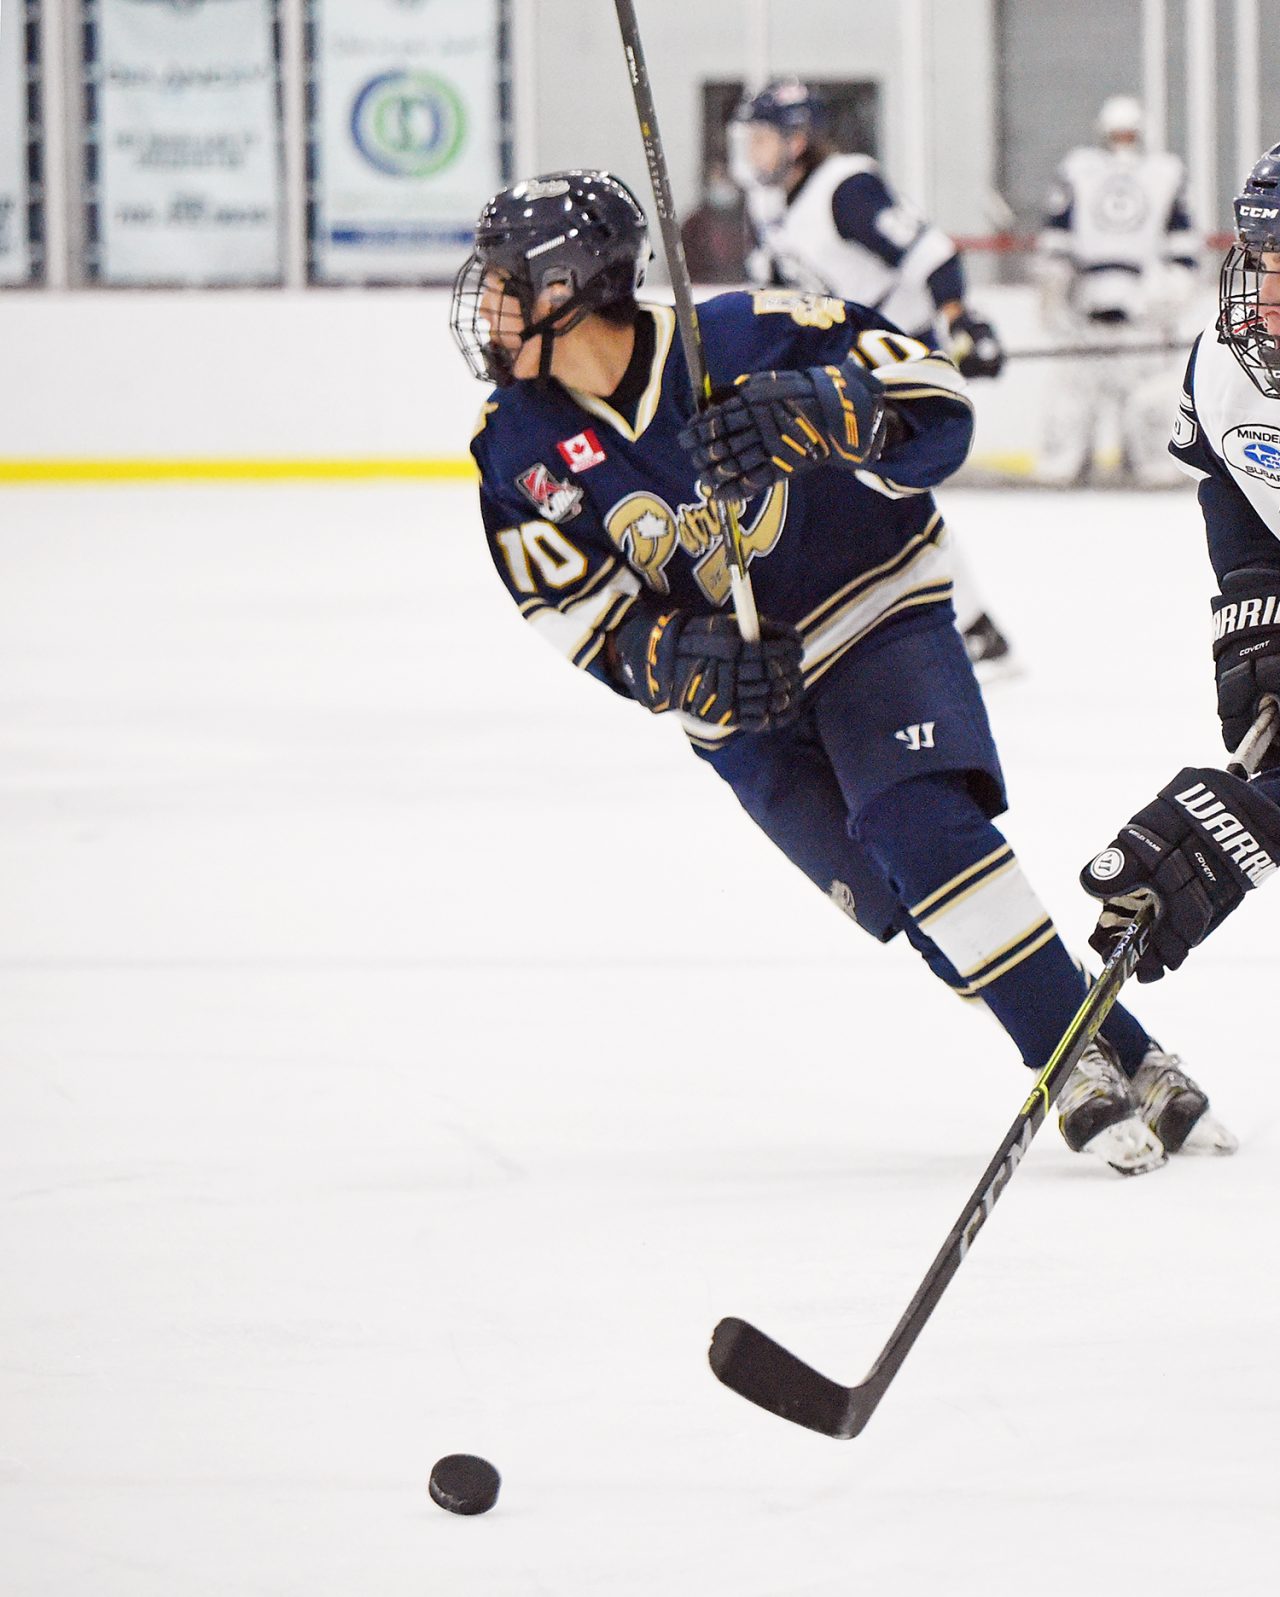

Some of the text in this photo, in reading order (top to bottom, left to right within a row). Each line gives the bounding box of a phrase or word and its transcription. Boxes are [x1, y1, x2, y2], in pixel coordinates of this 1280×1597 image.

[1239, 205, 1279, 219] CCM
[1239, 639, 1271, 656] COVERT
[1194, 851, 1217, 882] COVERT
